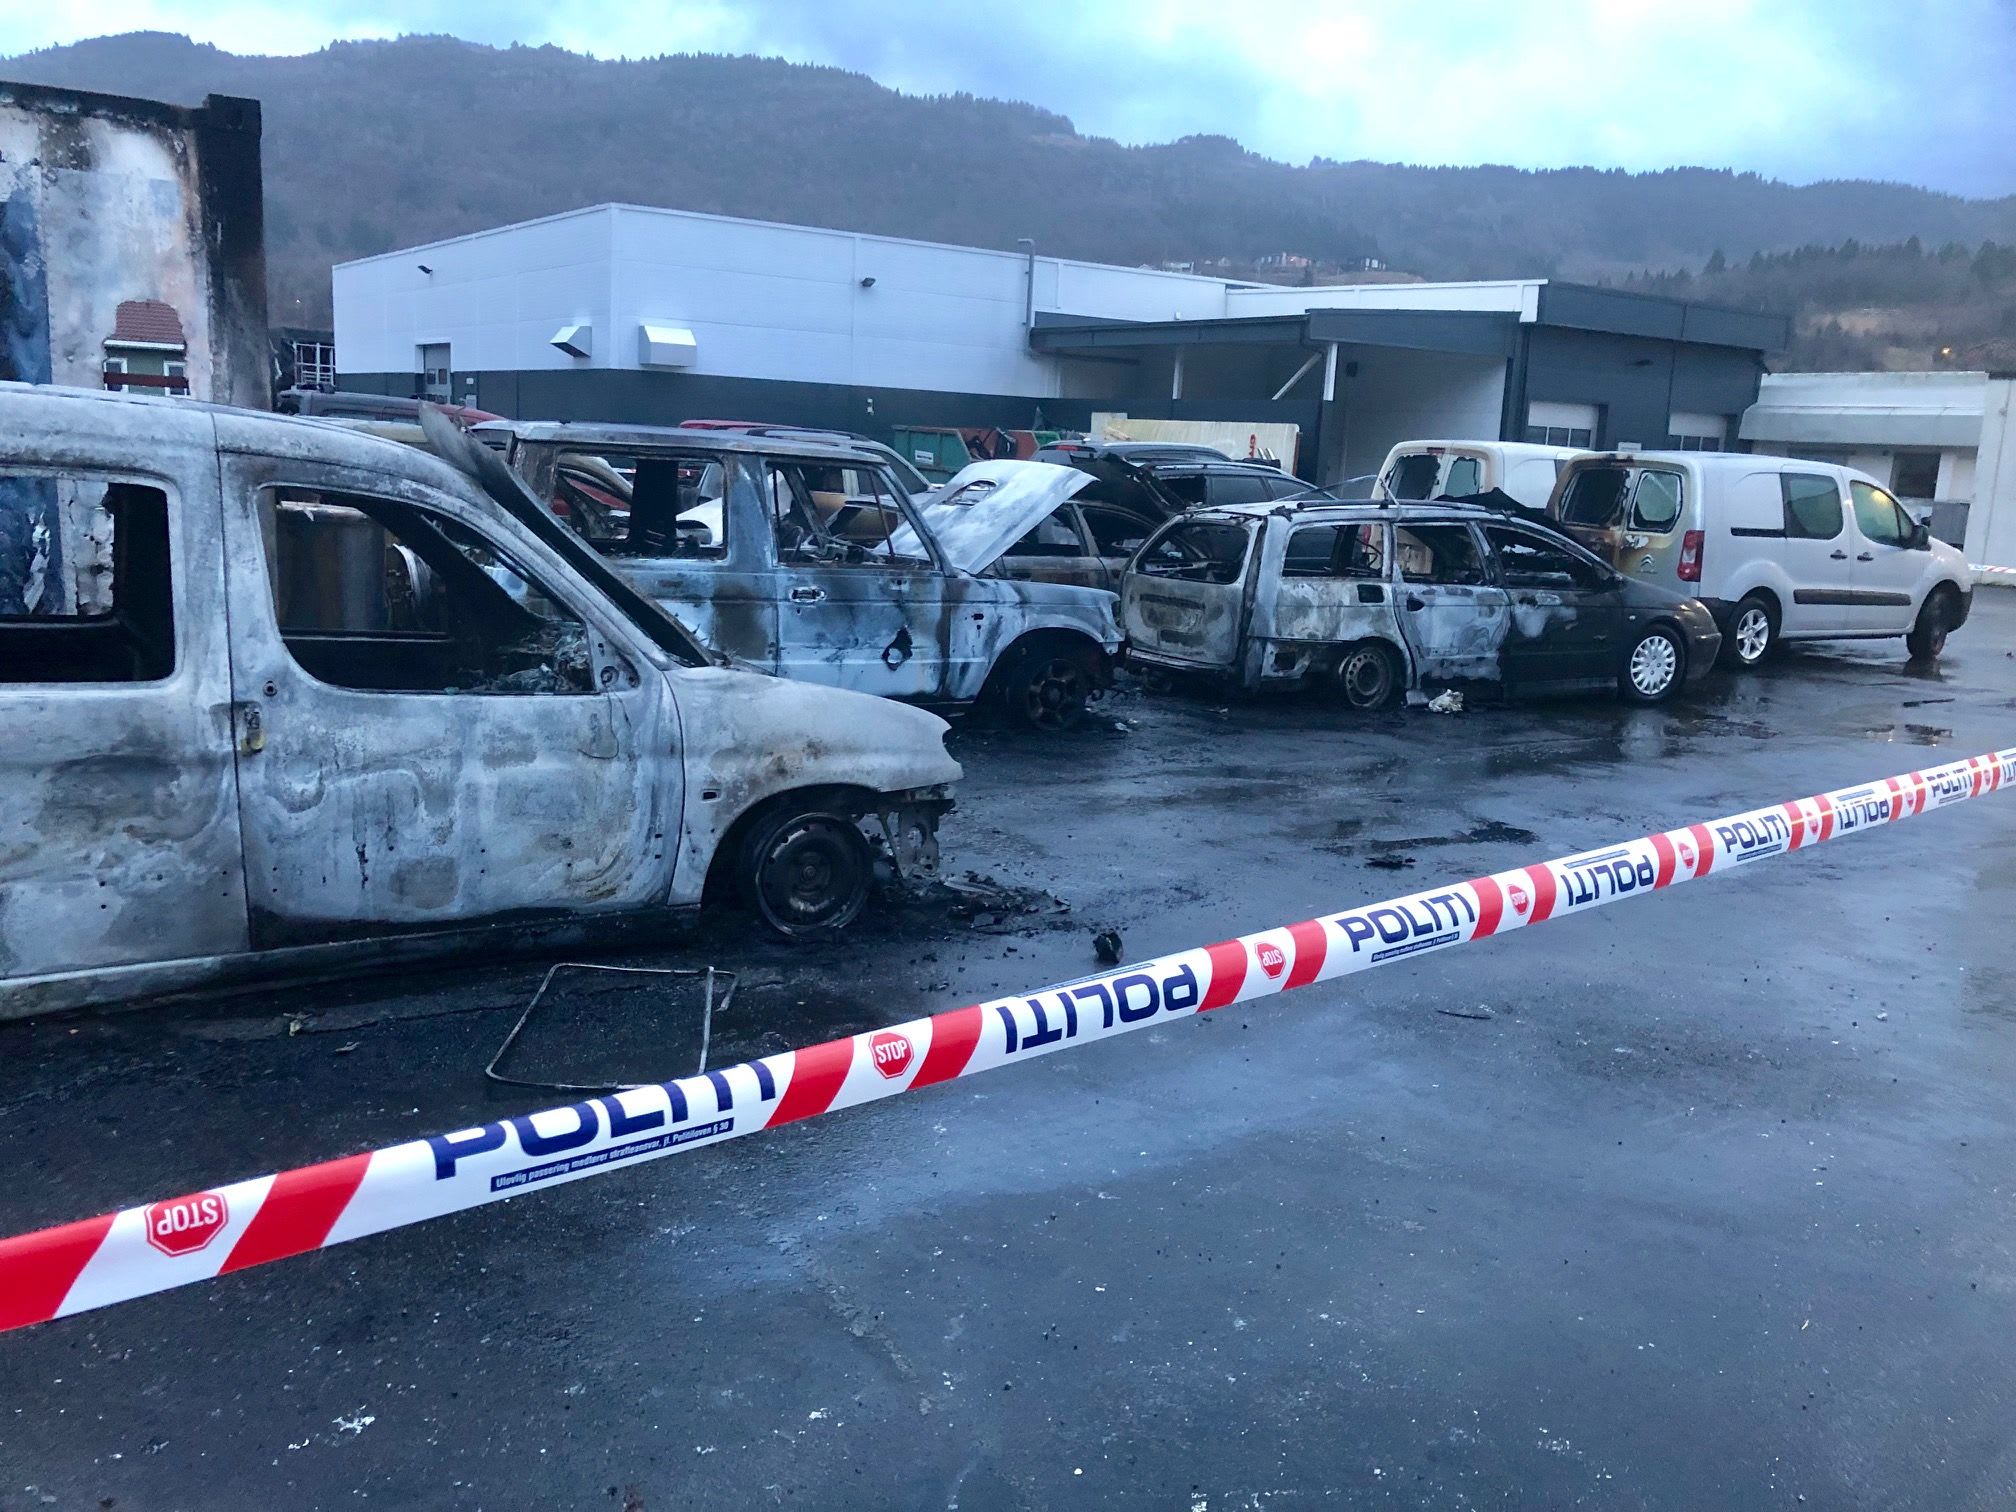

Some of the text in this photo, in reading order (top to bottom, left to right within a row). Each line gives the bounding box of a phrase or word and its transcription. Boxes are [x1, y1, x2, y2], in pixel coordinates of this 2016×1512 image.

[1715, 814, 1790, 854] POLITI
[1560, 854, 1654, 907] POLITI
[1335, 892, 1476, 953] POLITI
[1262, 949, 1283, 967] STOP
[997, 963, 1198, 1054] POLITI
[875, 1039, 908, 1064] STOP
[430, 1059, 777, 1181] POLITI
[528, 1162, 570, 1181] passering
[157, 1198, 219, 1236] STOP
